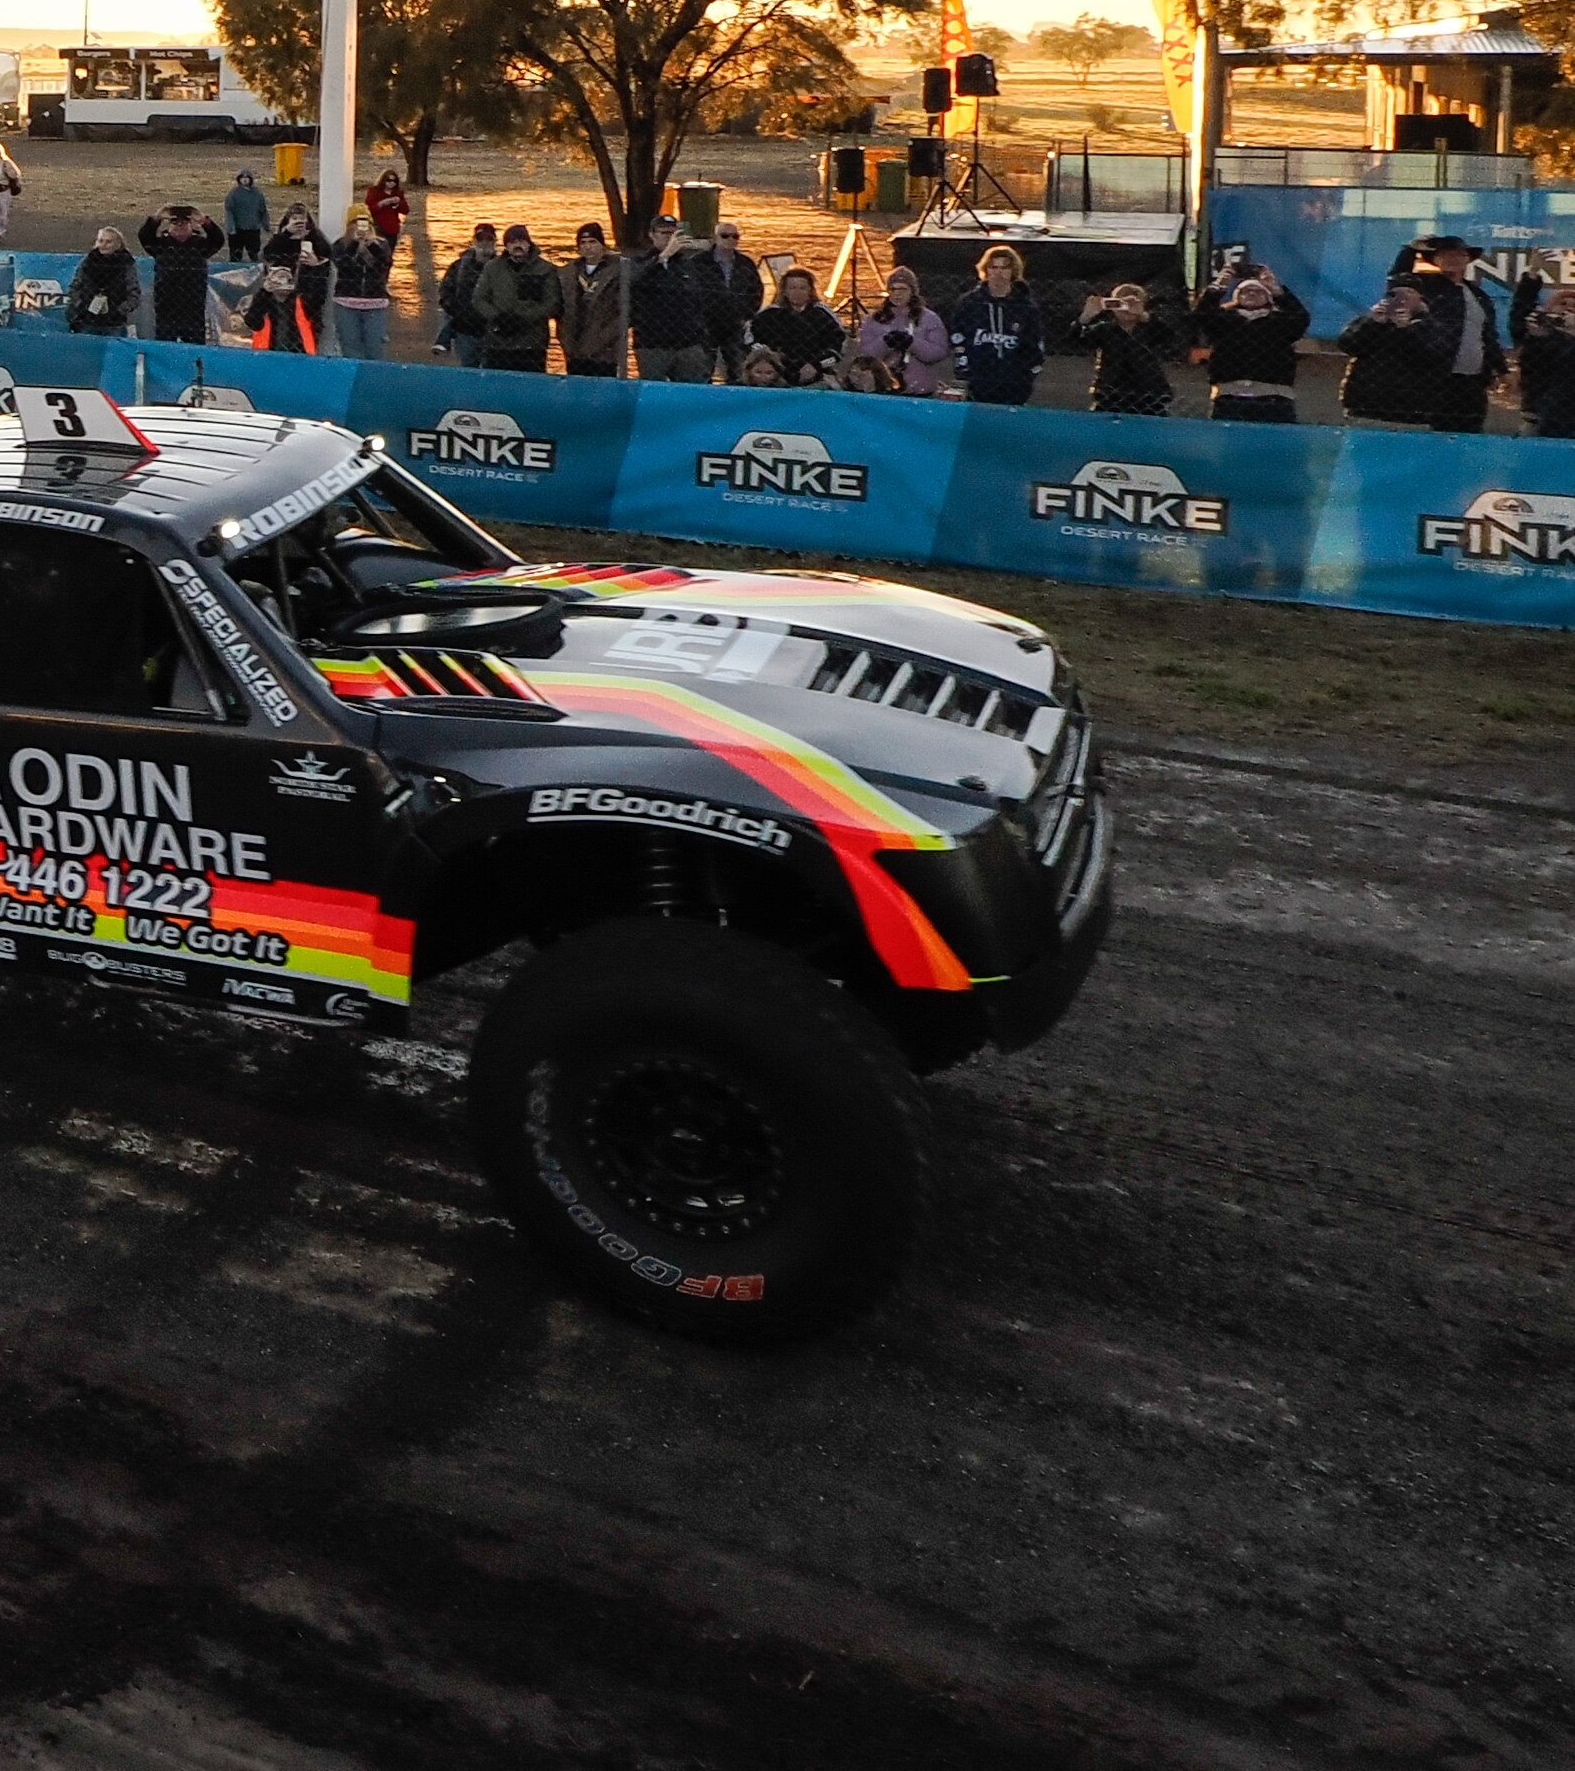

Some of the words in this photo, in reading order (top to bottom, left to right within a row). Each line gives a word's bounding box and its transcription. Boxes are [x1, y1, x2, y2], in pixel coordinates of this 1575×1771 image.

[45, 392, 87, 438] 3
[410, 431, 553, 469] FINKE
[428, 464, 483, 480] DESERT
[485, 469, 525, 483] RACE
[701, 456, 863, 497] FINKE
[721, 492, 784, 508] DESERT
[787, 498, 834, 513] RACE
[1035, 486, 1223, 531] FINKE
[1060, 524, 1133, 541] DESERT
[1135, 531, 1188, 547] RACE
[1424, 519, 1575, 561] FINK
[183, 576, 300, 722] SPECIALIZED
[9, 747, 194, 824] ODIN
[529, 787, 793, 849] BFGoodrich
[101, 863, 213, 920] 1222
[60, 905, 95, 935] It
[125, 915, 183, 949] We
[187, 922, 249, 960] Got
[253, 931, 288, 965] It
